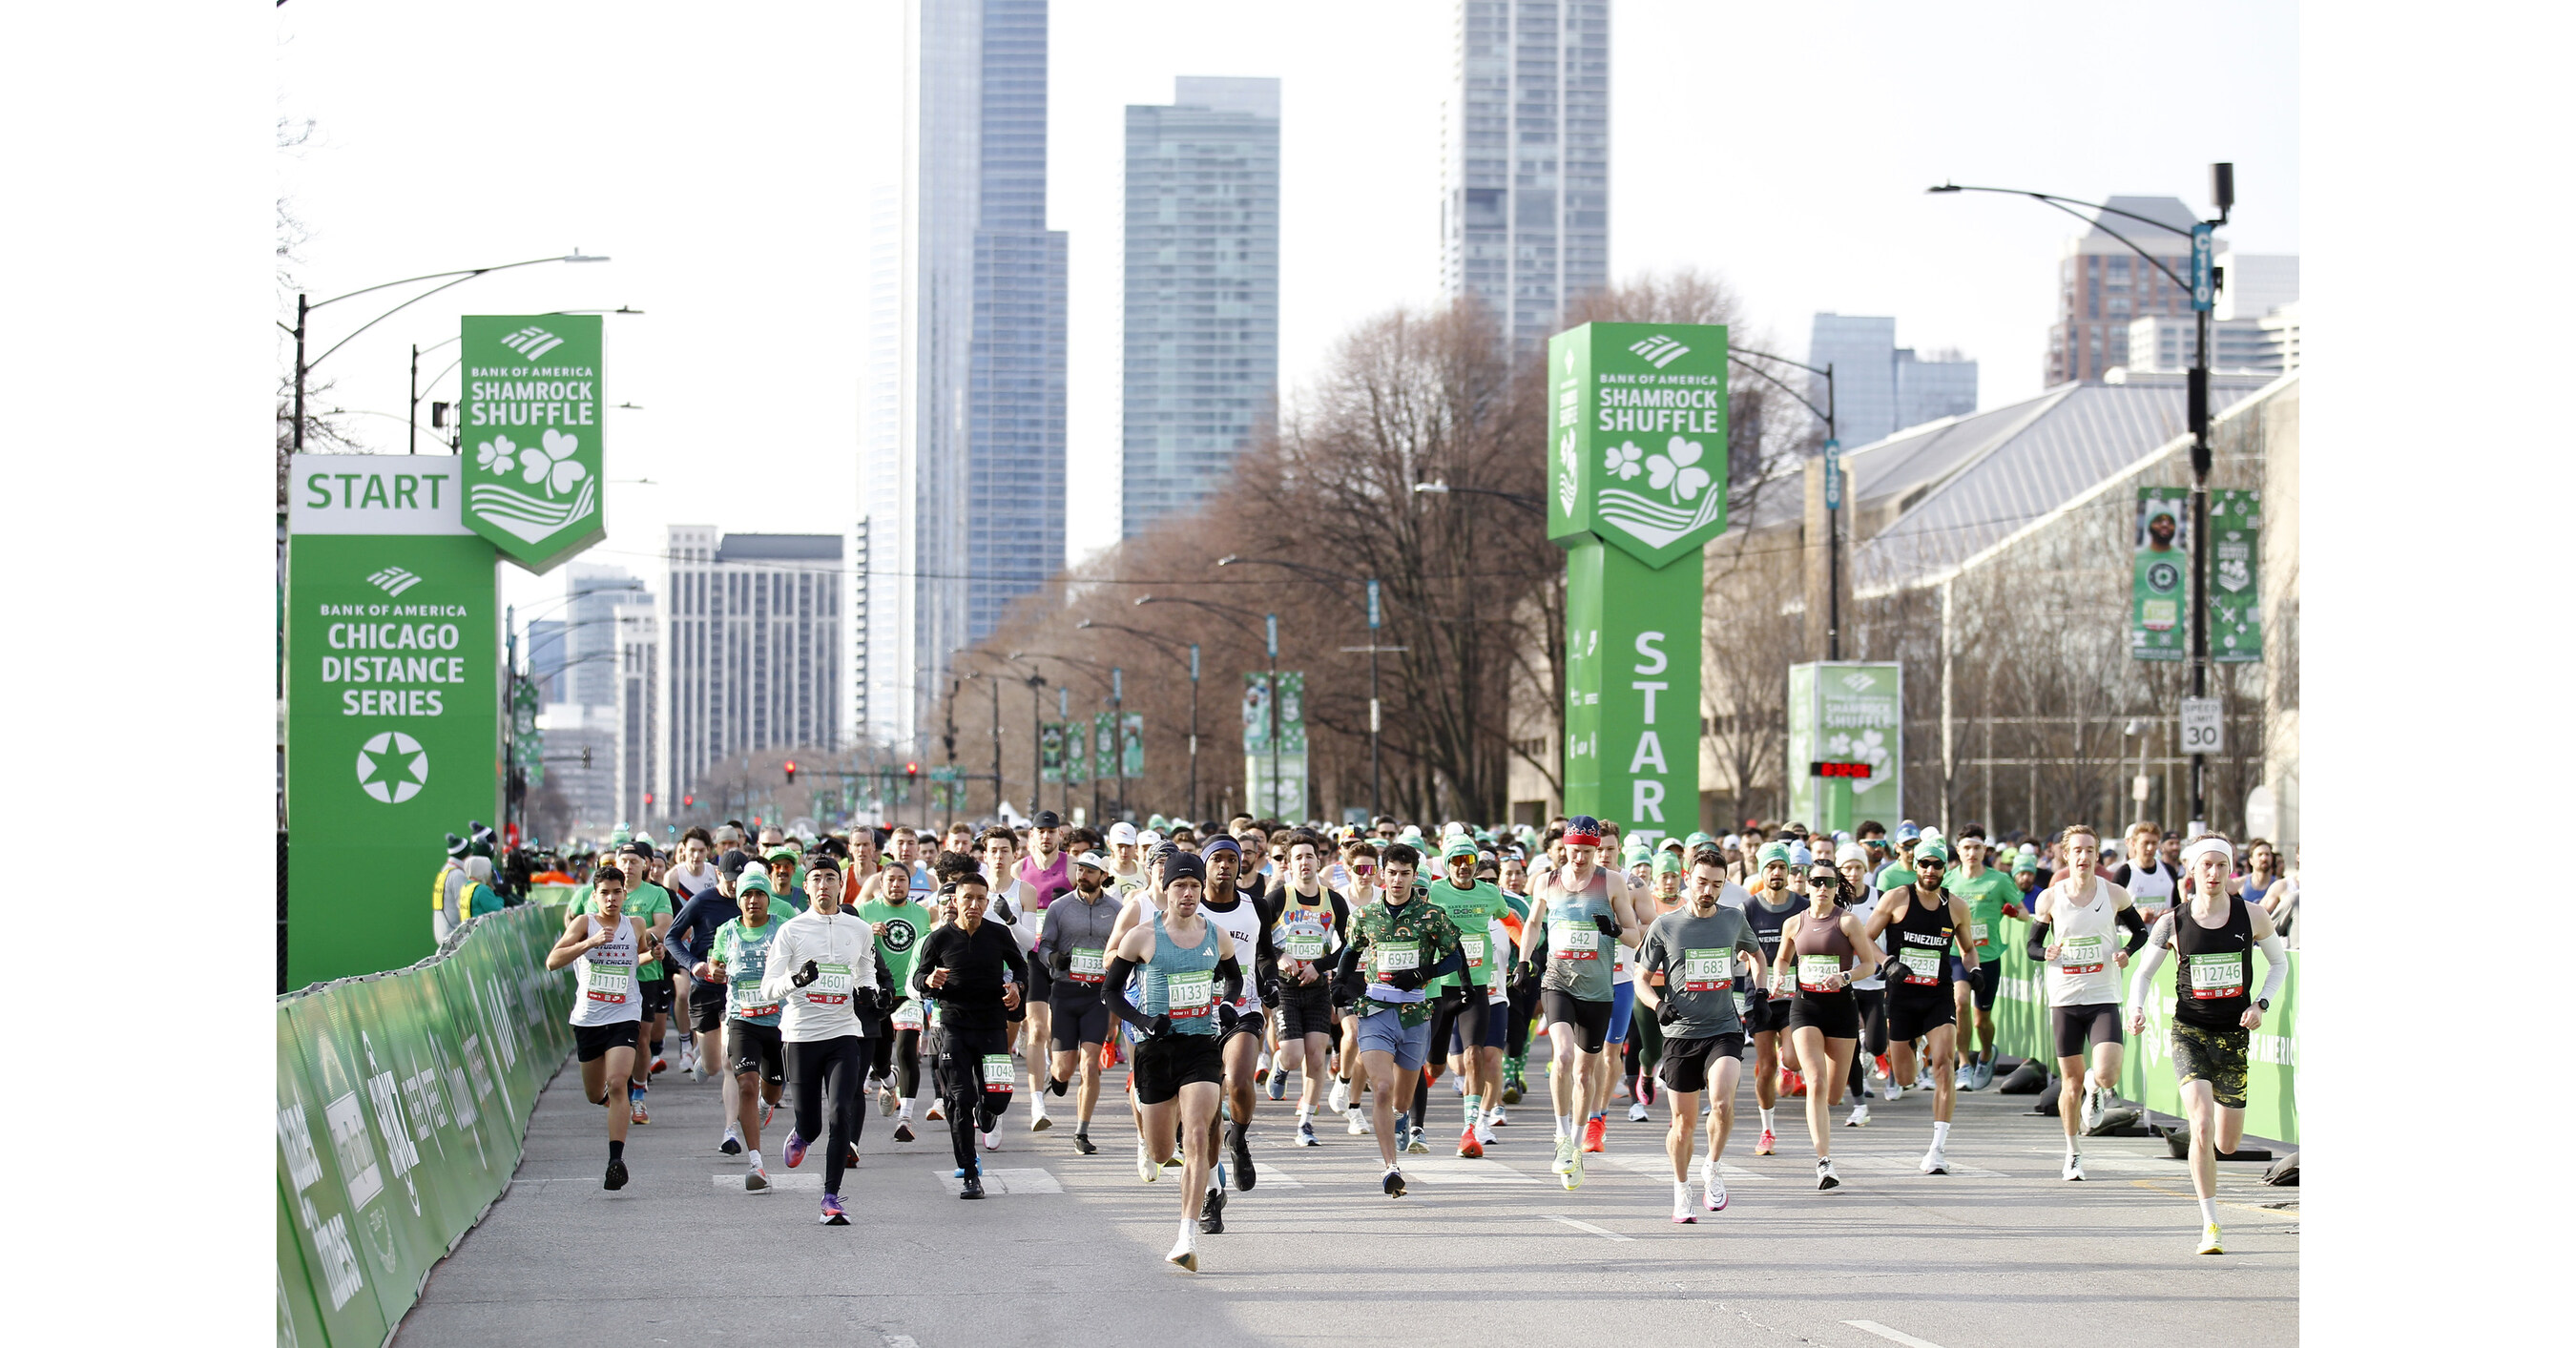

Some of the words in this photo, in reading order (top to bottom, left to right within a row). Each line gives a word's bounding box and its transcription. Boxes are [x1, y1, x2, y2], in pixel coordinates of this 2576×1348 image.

[2194, 233, 2211, 303] C110
[471, 367, 509, 377] BANK
[511, 367, 529, 377] OF
[532, 367, 593, 377] AMERICA
[1599, 373, 1635, 384] BANK
[1638, 374, 1655, 384] OF
[1658, 375, 1717, 385] AMERICA
[471, 382, 592, 401] SHAMROCK
[1599, 387, 1717, 408] SHAMROCK
[470, 402, 594, 425] SHUFFLE
[1599, 408, 1718, 433] SHUFFLE
[1825, 446, 1839, 504] C120
[306, 473, 449, 509] START
[321, 604, 364, 616] BANK
[368, 604, 389, 616] OF
[393, 605, 467, 617] AMERICA
[328, 623, 460, 650] CHICAGO
[322, 655, 465, 683] DISTANCE
[343, 689, 444, 716] SERIES
[2184, 704, 2218, 714] SPEED
[2188, 715, 2213, 724] LIMIT
[1629, 631, 1669, 840] STAR
[2187, 726, 2217, 745] 30
[1570, 932, 1589, 945] 642
[1295, 944, 1321, 956] 10450
[2069, 946, 2100, 961] 12731
[1388, 952, 1415, 965] 6972
[1910, 958, 1936, 972] 6238
[1688, 963, 1694, 974] A
[1703, 960, 1723, 974] 683
[2203, 964, 2241, 982] 12746
[598, 975, 627, 989] 11119
[820, 975, 845, 989] 4601
[1172, 987, 1179, 1002] A
